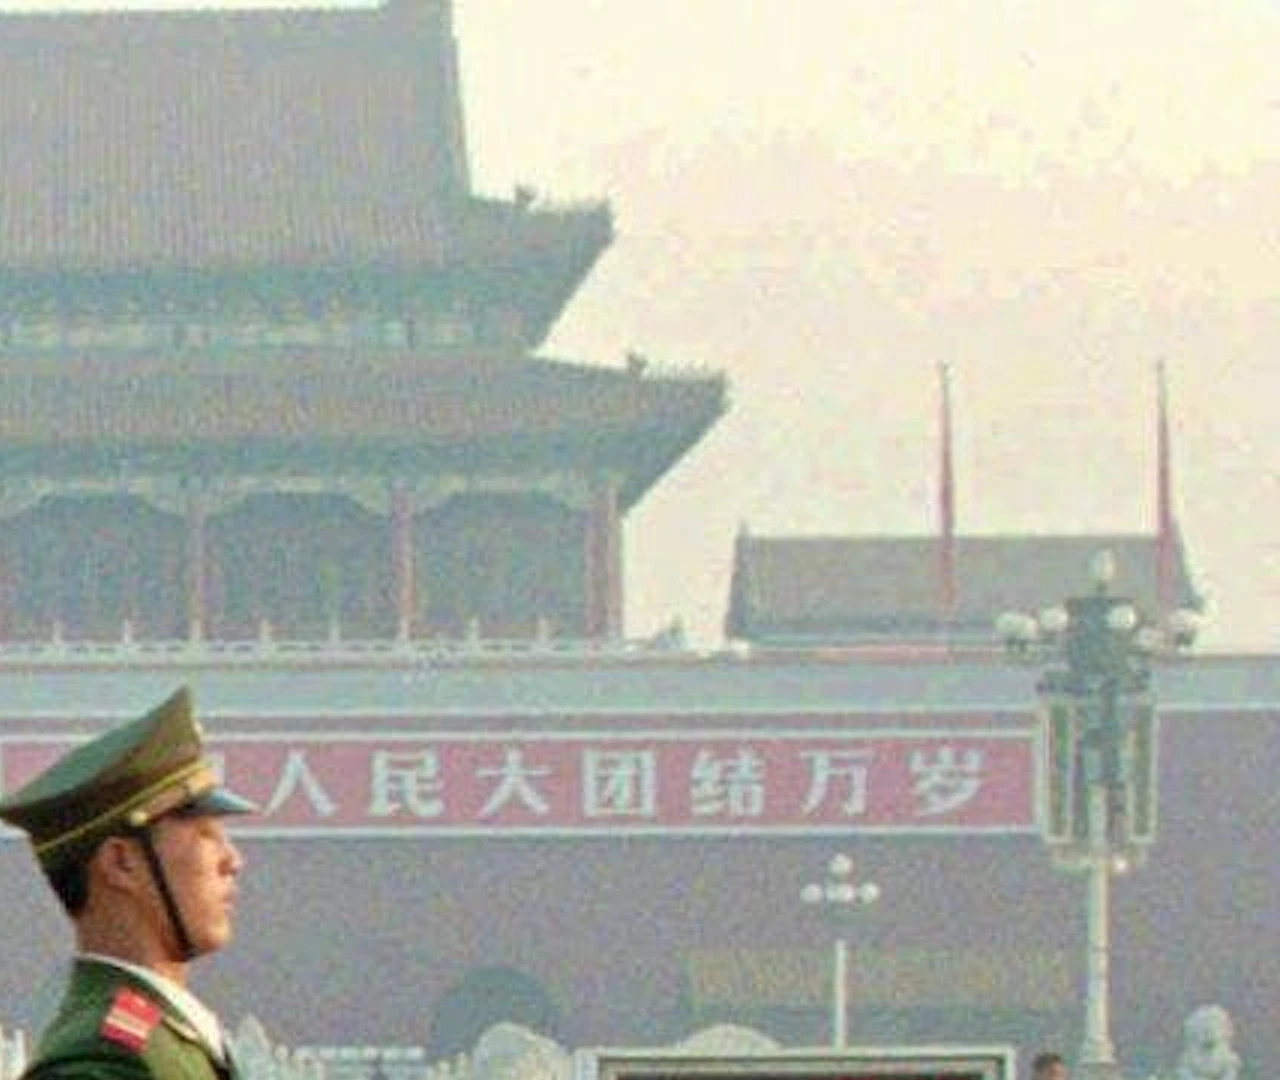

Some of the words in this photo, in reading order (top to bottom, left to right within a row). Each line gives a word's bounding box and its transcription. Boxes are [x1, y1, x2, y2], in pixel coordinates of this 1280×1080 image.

[198, 747, 984, 818] 人民大团结万岁
